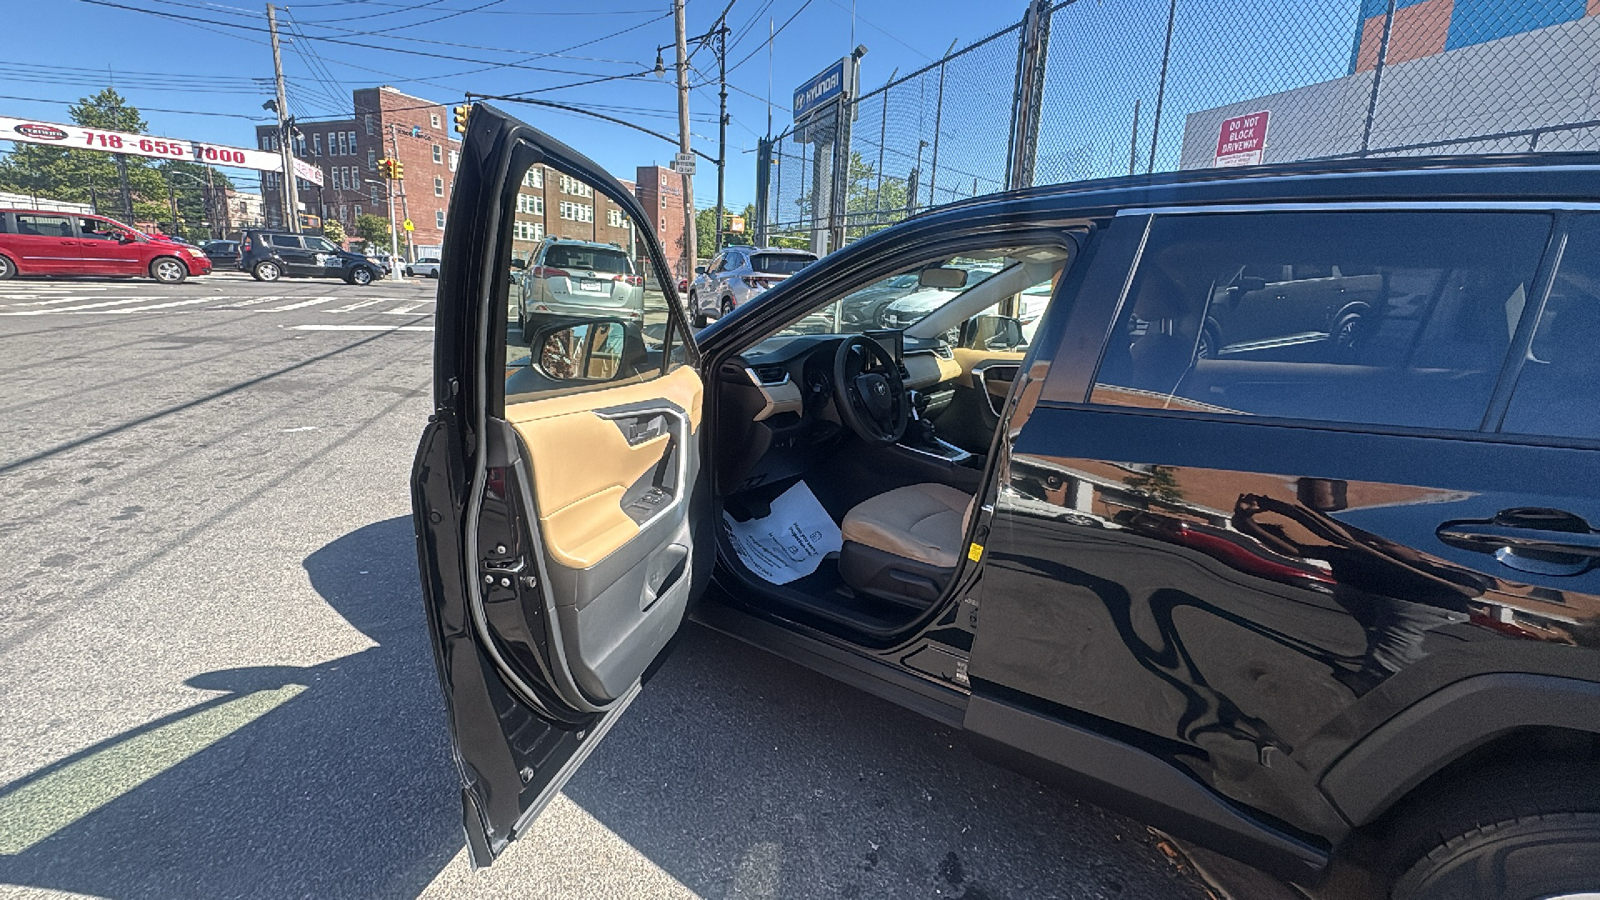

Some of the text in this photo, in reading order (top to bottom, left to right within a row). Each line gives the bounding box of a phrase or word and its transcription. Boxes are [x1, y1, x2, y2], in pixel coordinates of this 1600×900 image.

[806, 72, 839, 103] HYUNDAI
[1229, 117, 1259, 131] DO NOT
[1229, 128, 1254, 141] BLOCK
[1221, 138, 1258, 153] DRIVEWAY
